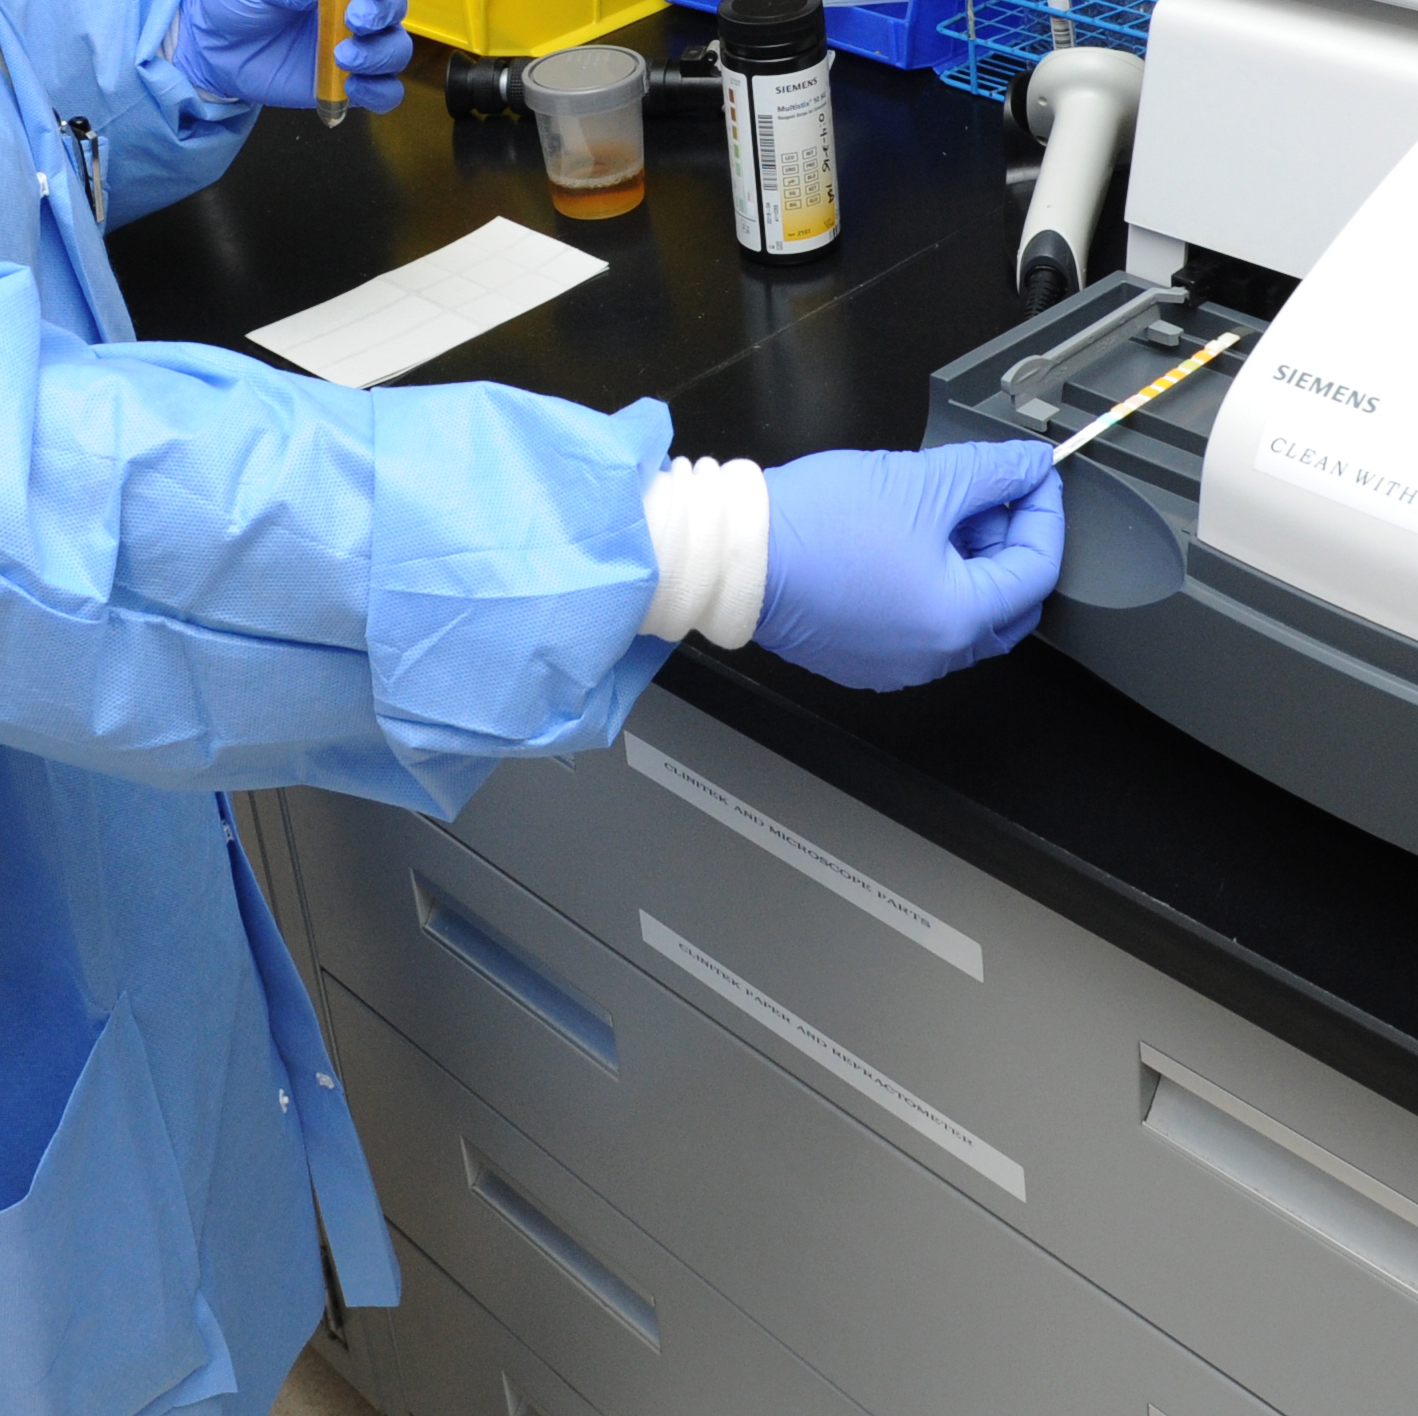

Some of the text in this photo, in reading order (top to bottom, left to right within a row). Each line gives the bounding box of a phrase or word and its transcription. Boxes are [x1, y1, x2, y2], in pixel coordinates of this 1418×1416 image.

[775, 76, 818, 95] SIEMENS
[1272, 363, 1381, 415] SIEMENS
[1270, 436, 1349, 477] CLEAN
[663, 761, 932, 930] CLINITEK AND MICROSCOPE PARTS
[797, 1025, 828, 1049] AND
